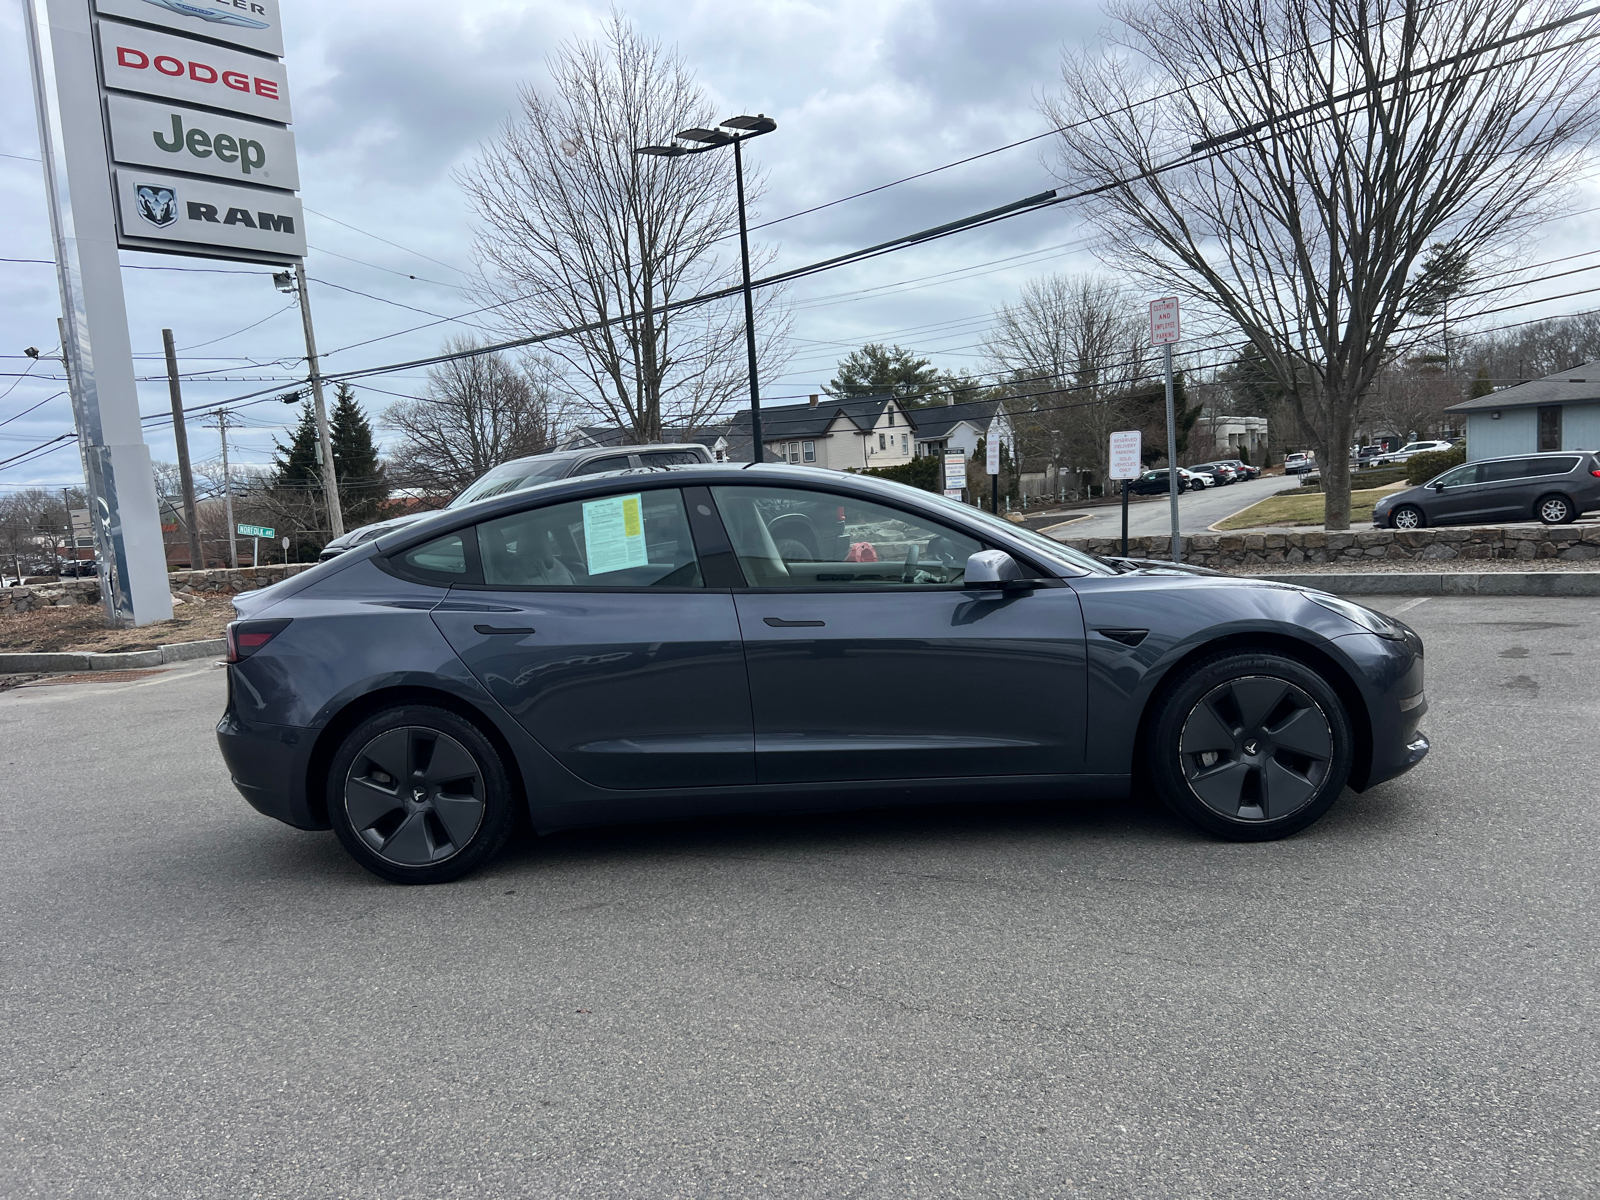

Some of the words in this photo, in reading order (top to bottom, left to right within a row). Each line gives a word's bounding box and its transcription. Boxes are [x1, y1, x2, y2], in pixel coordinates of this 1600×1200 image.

[116, 46, 280, 100] DODGE
[152, 113, 266, 175] Jeep
[186, 201, 295, 235] RAM
[1153, 302, 1174, 312] CUSTOMER
[1155, 321, 1175, 331] EMPLOYEE
[1156, 331, 1175, 340] PARKING
[239, 525, 264, 536] NORFOLK
